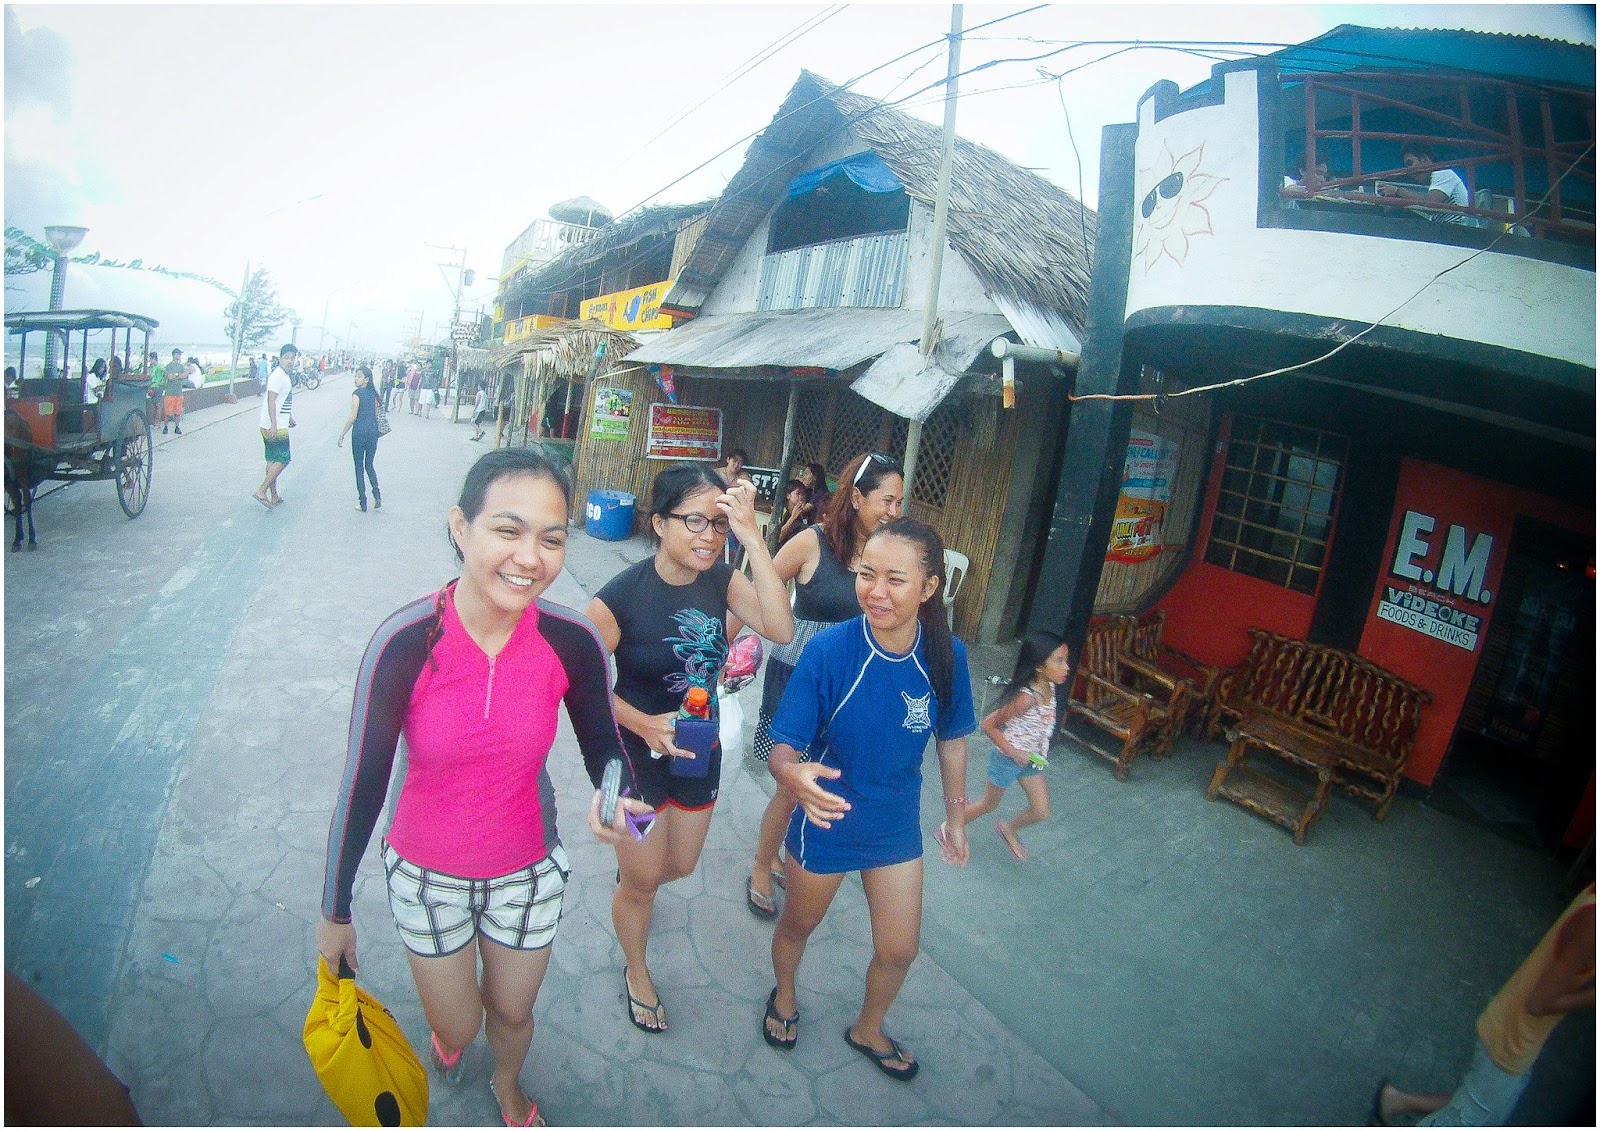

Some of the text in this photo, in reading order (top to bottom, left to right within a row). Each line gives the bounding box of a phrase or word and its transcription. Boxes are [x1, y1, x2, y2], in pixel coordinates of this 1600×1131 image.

[749, 473, 779, 490] ST?
[1392, 509, 1492, 604] E.M.
[1408, 585, 1455, 605] BEACH
[1380, 604, 1471, 647] FOODS & DRINKS
